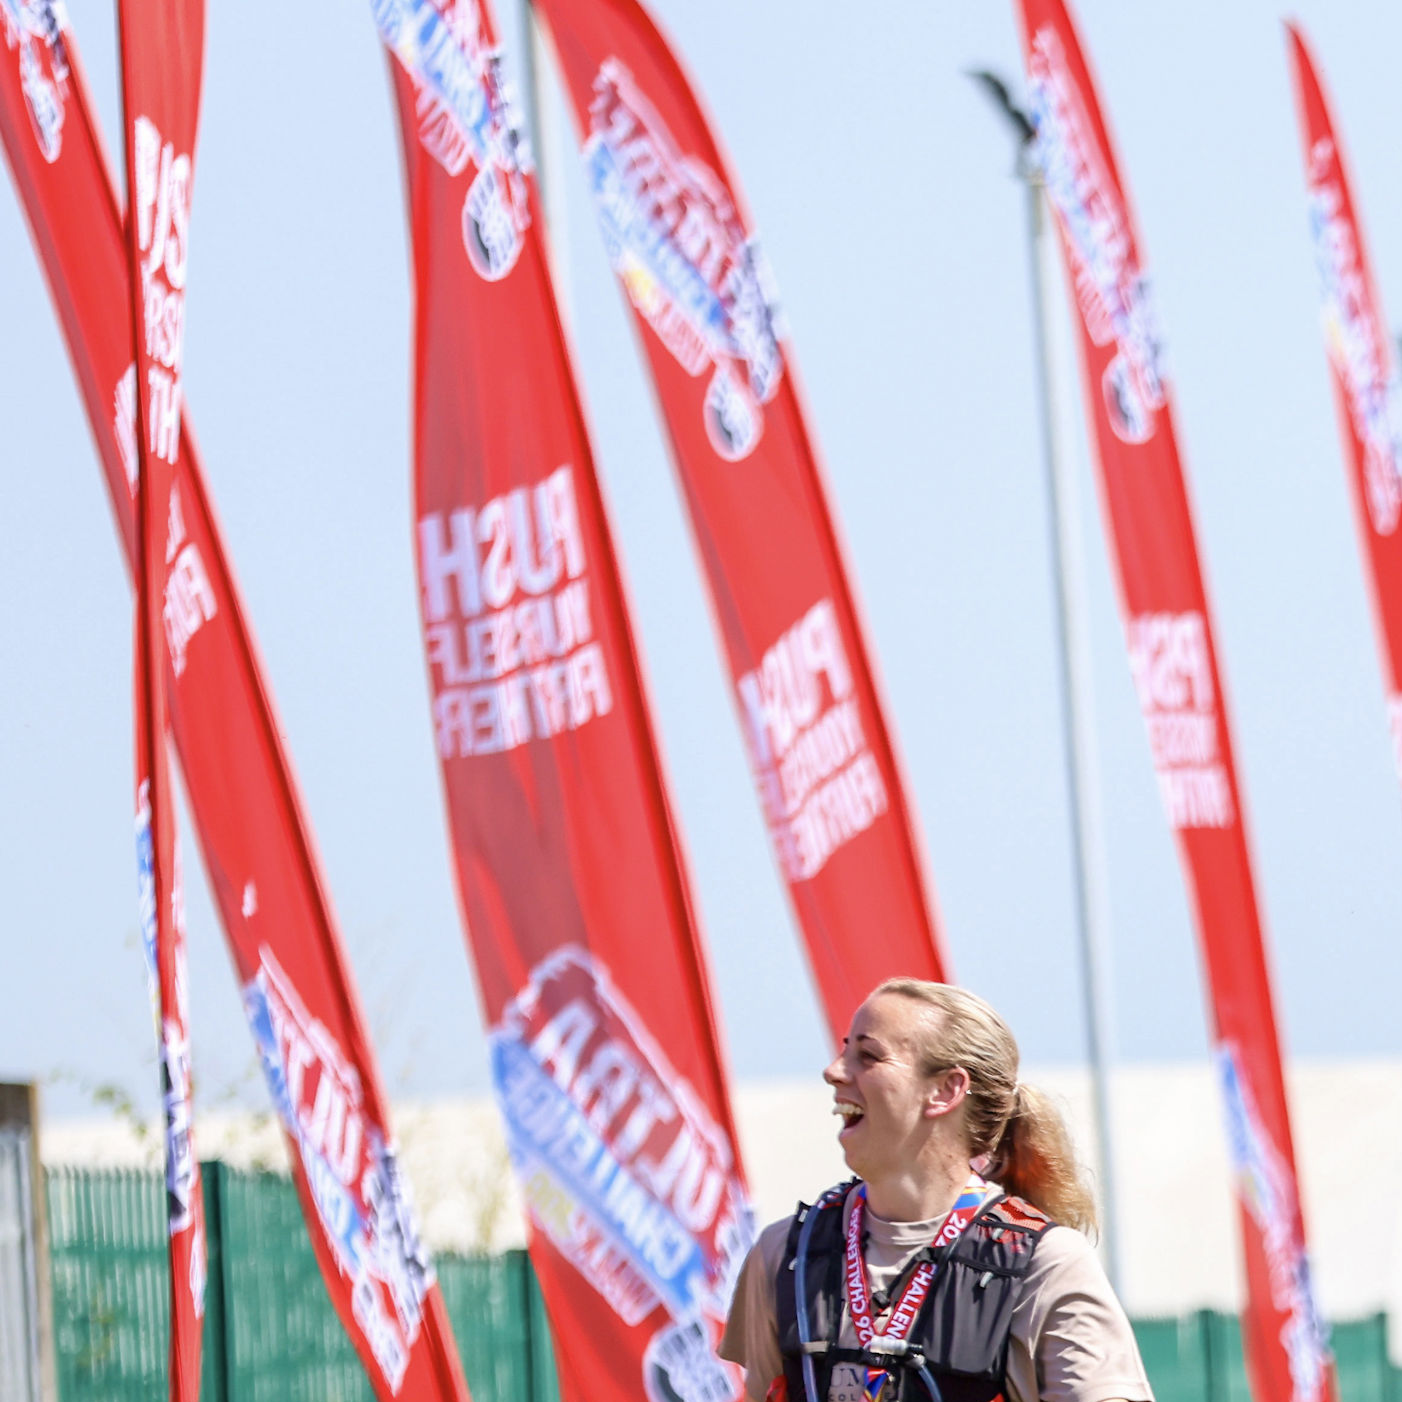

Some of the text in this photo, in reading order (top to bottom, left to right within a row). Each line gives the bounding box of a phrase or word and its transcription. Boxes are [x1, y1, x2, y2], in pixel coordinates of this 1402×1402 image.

[846, 1206, 876, 1350] 26 CHALLENGER
[884, 1261, 938, 1345] CHALLEN
